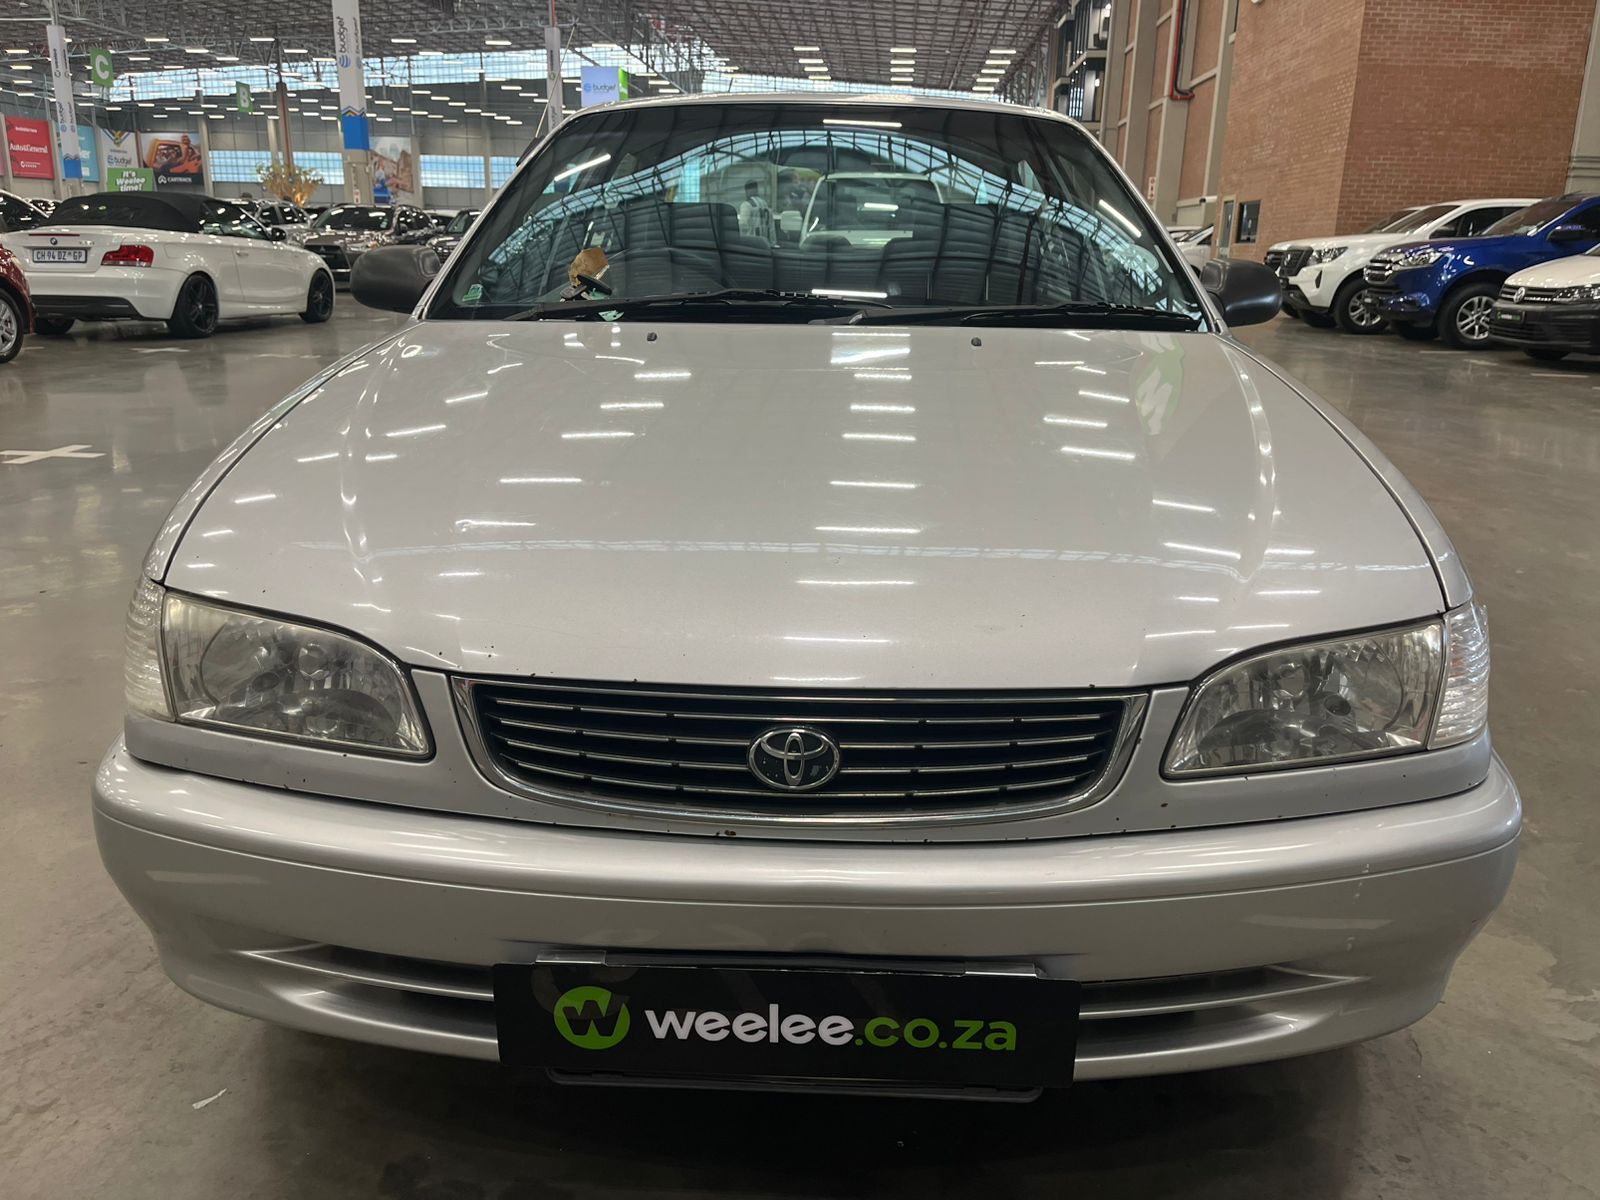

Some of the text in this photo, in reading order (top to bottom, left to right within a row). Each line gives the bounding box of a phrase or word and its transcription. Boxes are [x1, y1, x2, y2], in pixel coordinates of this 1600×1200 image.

[336, 15, 348, 54] budget
[95, 54, 109, 80] C
[593, 83, 616, 92] budget
[239, 87, 250, 108] B
[122, 170, 136, 178] It's
[120, 183, 143, 192] time!
[36, 250, 83, 260] CH 94 DZ GP
[644, 1003, 1017, 1052] weelee.co.za
